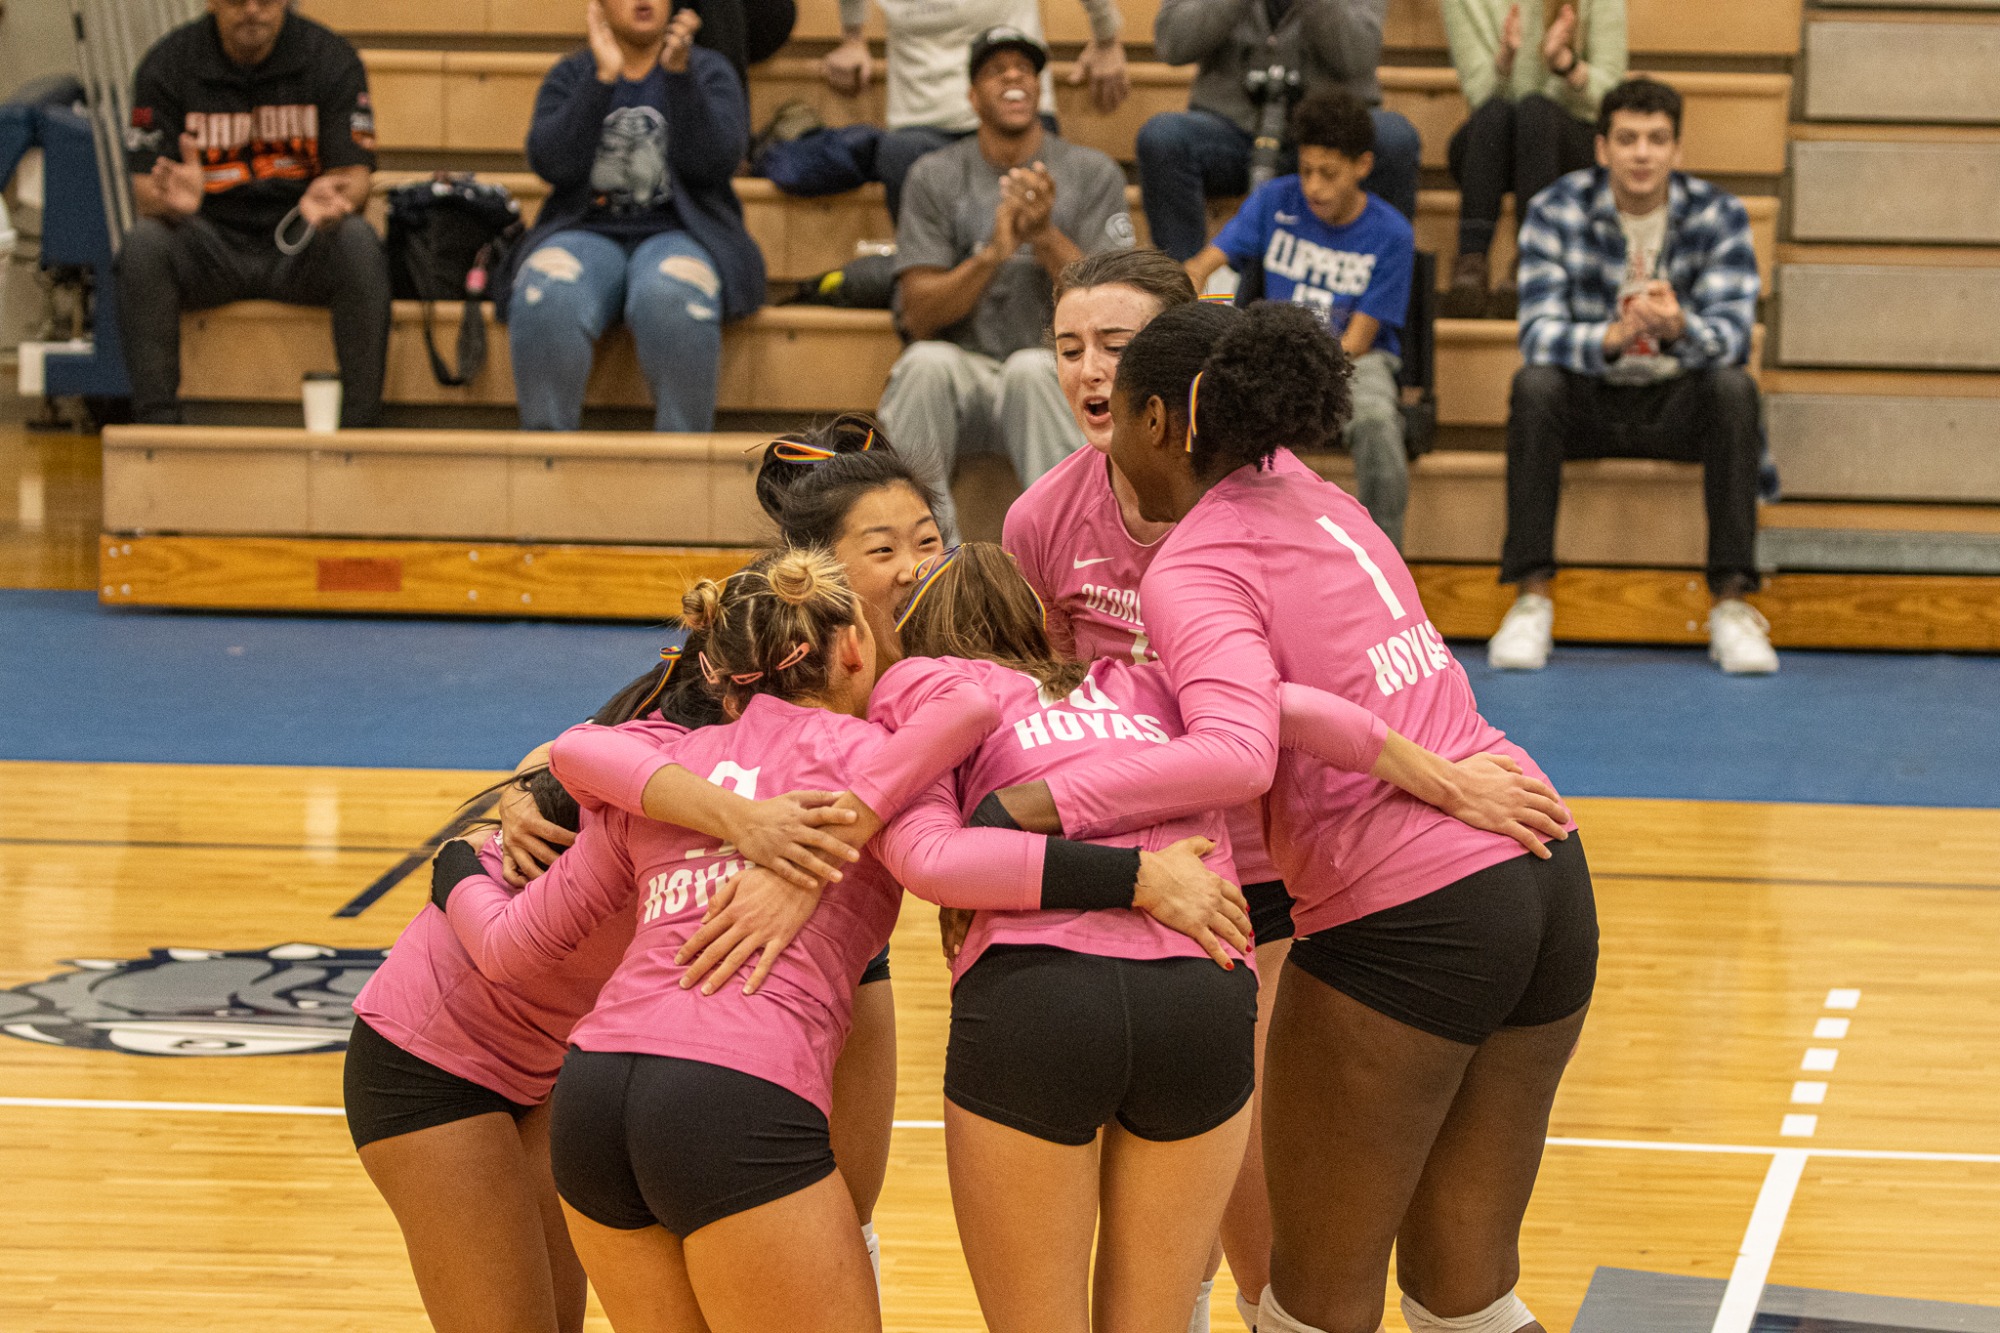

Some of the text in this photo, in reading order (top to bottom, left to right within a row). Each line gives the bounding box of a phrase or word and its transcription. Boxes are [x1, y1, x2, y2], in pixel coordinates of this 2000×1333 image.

[1263, 228, 1377, 297] CLIPPERS
[1315, 515, 1407, 621] 1
[1013, 709, 1171, 751] HOYAS
[643, 859, 755, 925] HOYA
